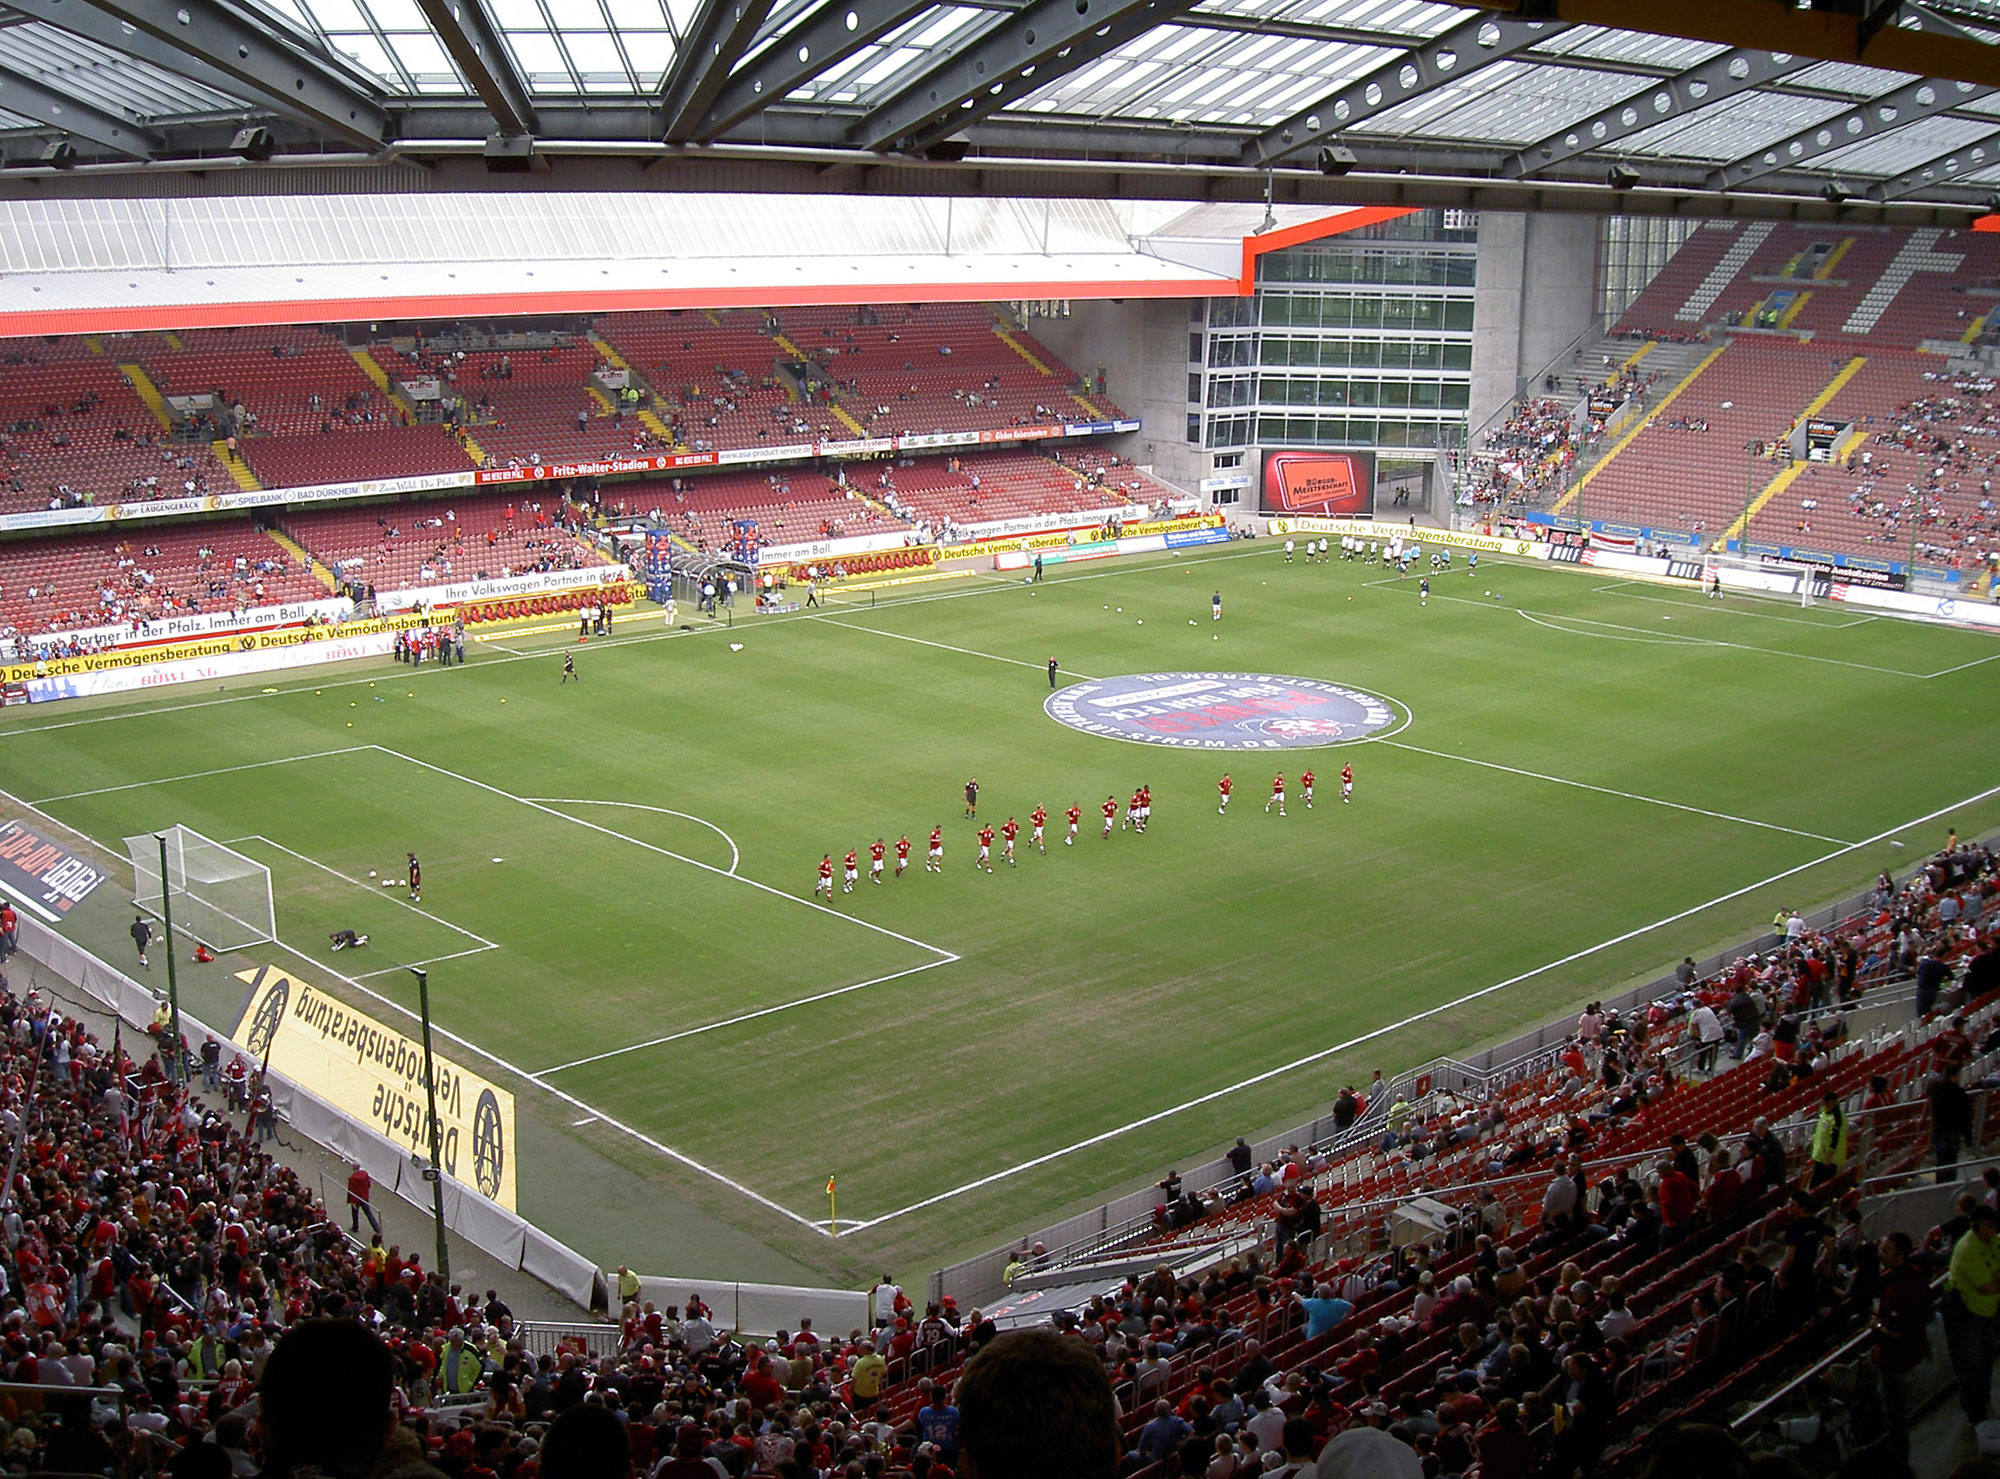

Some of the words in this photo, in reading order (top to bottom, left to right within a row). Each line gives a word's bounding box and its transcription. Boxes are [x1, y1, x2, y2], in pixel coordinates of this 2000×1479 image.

[552, 458, 649, 477] Fritz-Walter-Stadion
[238, 492, 283, 506] SPIELBANK
[297, 490, 315, 500] BAD
[316, 486, 358, 499] DÜRKHEIM
[1004, 522, 1033, 533] Partner
[1035, 519, 1043, 529] in
[1044, 519, 1057, 528] der
[1139, 518, 1215, 535] Vermögensberatng
[1301, 519, 1366, 534] Deutsche
[1372, 524, 1503, 551] Vermögensberatung
[761, 549, 793, 561] Immer
[794, 549, 809, 558] am
[944, 546, 985, 559] Deutsche
[1832, 566, 1889, 581] Anstoßzeiten
[446, 587, 468, 599] Ihre
[471, 581, 540, 596] Volkswagen
[544, 574, 583, 587] Partner
[586, 572, 596, 583] in
[71, 629, 122, 646] Partner
[125, 627, 138, 640] in
[142, 622, 162, 637] der
[168, 617, 205, 634] Pfalz.
[209, 612, 251, 629] Immer
[255, 611, 275, 624] am
[280, 606, 308, 621] Ball.
[12, 661, 80, 681] Deusche
[85, 642, 230, 671] Vermögensberatung
[294, 985, 462, 1120] Vermögensberatung
